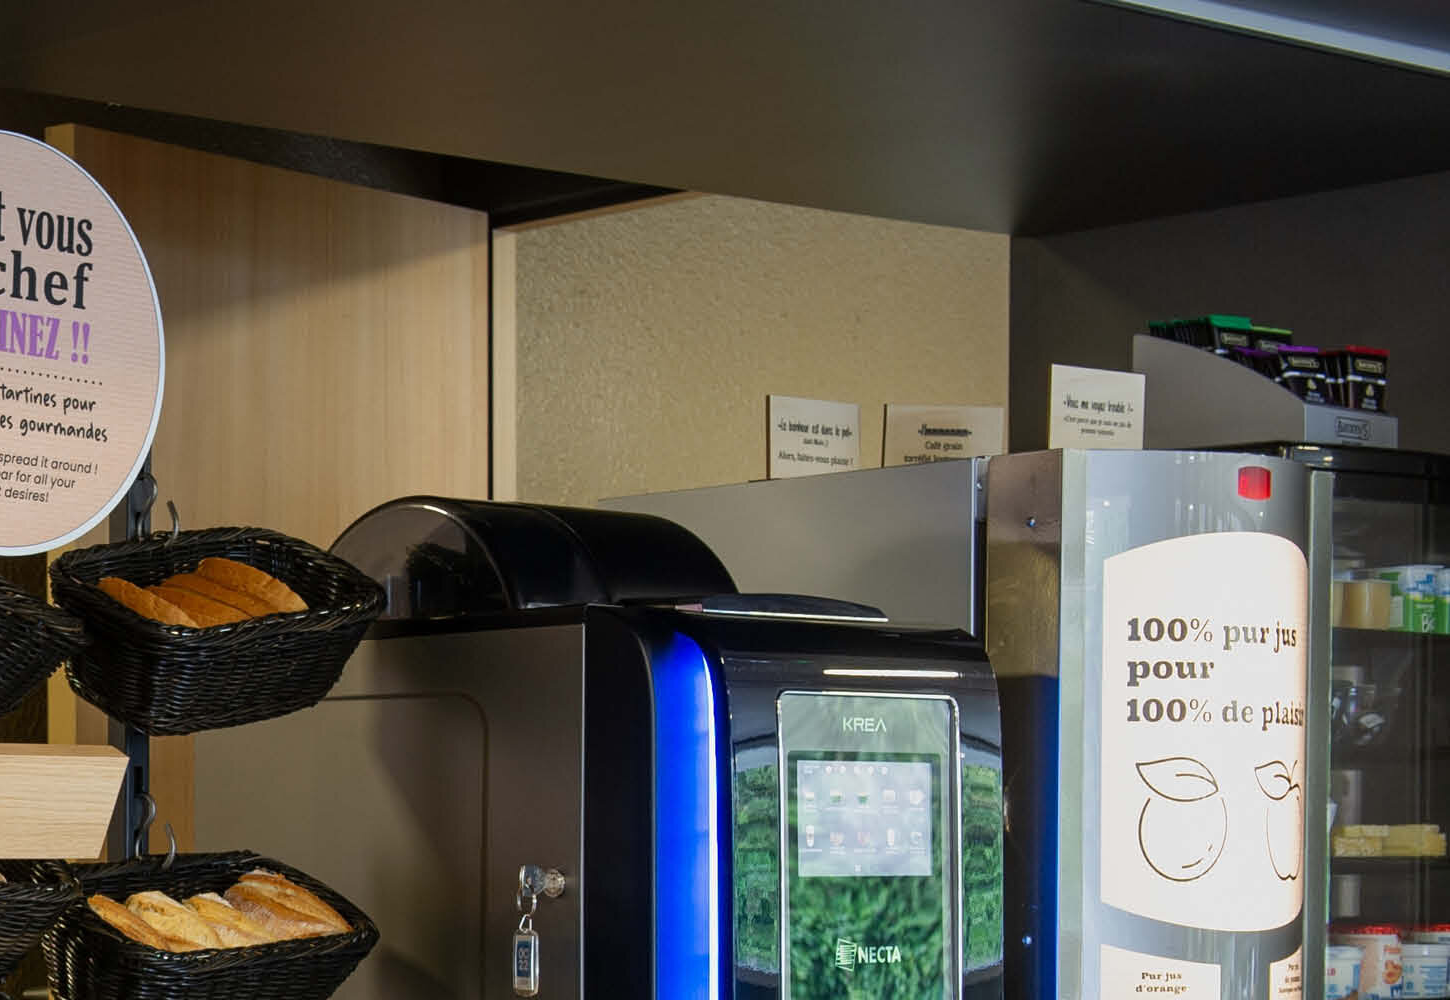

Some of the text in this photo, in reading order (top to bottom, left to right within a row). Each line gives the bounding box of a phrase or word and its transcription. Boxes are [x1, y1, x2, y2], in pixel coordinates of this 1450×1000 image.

[16, 207, 93, 257] vous
[0, 383, 58, 409] tartines
[62, 395, 97, 416] pour
[19, 416, 109, 443] gourmandes
[40, 455, 49, 469] it
[49, 456, 93, 475] around
[16, 468, 33, 483] for
[33, 470, 48, 486] all
[50, 475, 77, 495] your
[4, 488, 50, 503] desires!
[1126, 616, 1298, 654] 100% pur jus
[1126, 659, 1215, 687] pour
[1126, 698, 1213, 723] 100%
[1221, 699, 1254, 724] de
[842, 716, 888, 733] KREA
[857, 945, 902, 964] NECTA
[1135, 983, 1189, 995] d'orange
[1141, 970, 1183, 983] Pur jus
